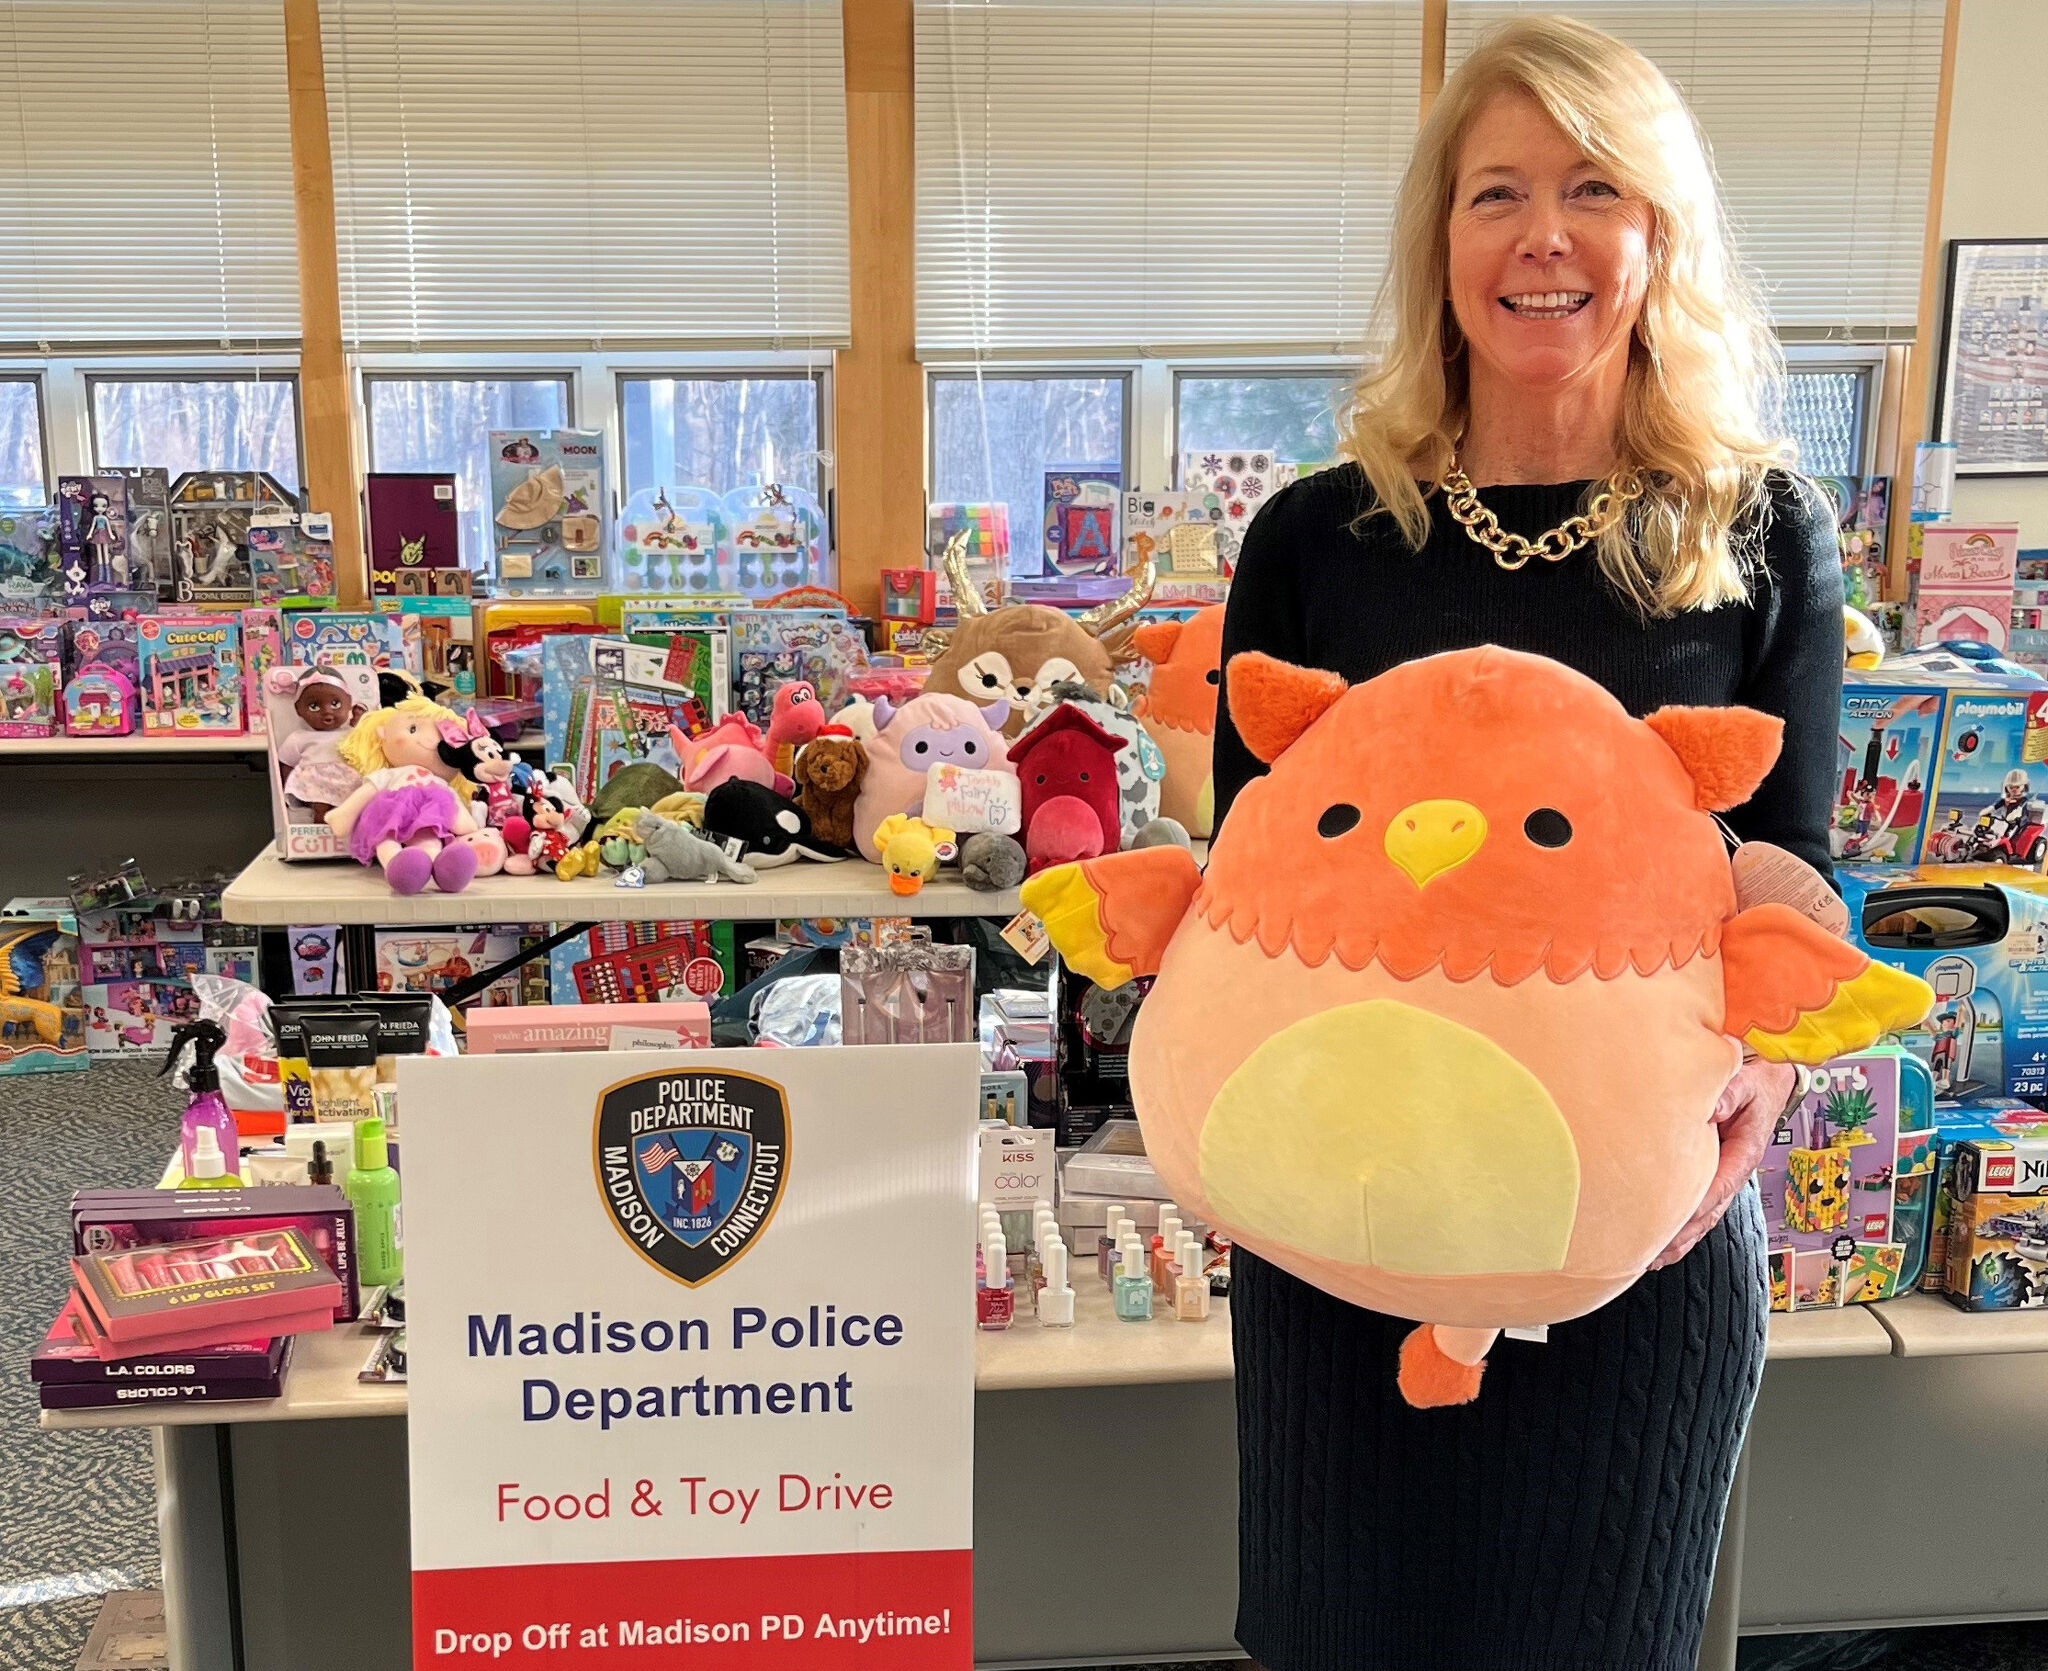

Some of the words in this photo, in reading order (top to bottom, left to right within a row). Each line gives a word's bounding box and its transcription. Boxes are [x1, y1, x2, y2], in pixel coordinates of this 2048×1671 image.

[563, 445, 597, 455] MOON
[1127, 497, 1155, 516] Big
[166, 631, 197, 645] Cute
[197, 629, 227, 644] Café
[1846, 697, 1890, 710] CITY
[1955, 701, 2024, 717] playmobil
[1849, 710, 1893, 719] ACTION
[960, 785, 992, 805] Fairy
[389, 1021, 420, 1030] FRIEDA
[311, 1034, 336, 1043] JOHN
[337, 1033, 369, 1043] FRIEDA
[523, 1022, 608, 1046] amazing
[2031, 1052, 2047, 1062] 4+
[1810, 1066, 1868, 1094] OTS
[2021, 1067, 2046, 1077] 70313
[288, 1083, 311, 1097] Vio
[658, 1078, 726, 1104] POLICE
[2013, 1082, 2028, 1093] 23
[2029, 1082, 2043, 1093] pc
[630, 1102, 755, 1134] DEPARTMENT
[1002, 1152, 1035, 1163] KISS
[1987, 1164, 2014, 1178] LEGO
[994, 1172, 1042, 1190] color
[604, 1145, 665, 1249] MADISON
[710, 1141, 781, 1257] CONNECTICUT
[335, 1217, 347, 1240] JELLY
[1864, 1218, 1886, 1232] LEGO
[337, 1240, 347, 1252] BE
[337, 1252, 348, 1270] LIPS
[168, 1295, 179, 1306] 6
[180, 1292, 202, 1304] LIP
[203, 1285, 251, 1300] GLOSS
[252, 1281, 276, 1293] SET
[467, 1311, 709, 1357] Madison
[733, 1305, 904, 1350] Police
[105, 1365, 132, 1376] L.A.
[133, 1364, 195, 1376] COLORS
[116, 1386, 178, 1399] COLORS
[180, 1385, 206, 1396] L.A.
[522, 1372, 854, 1430] Department
[498, 1478, 610, 1522] Food
[630, 1479, 663, 1517] &
[680, 1476, 761, 1524] Toy
[779, 1473, 894, 1512] Drive
[434, 1628, 513, 1658] Drop
[522, 1622, 573, 1649] Off
[580, 1624, 609, 1648] at
[618, 1617, 750, 1648] Madison
[761, 1614, 803, 1641] PD
[814, 1609, 951, 1644] Anytime!
